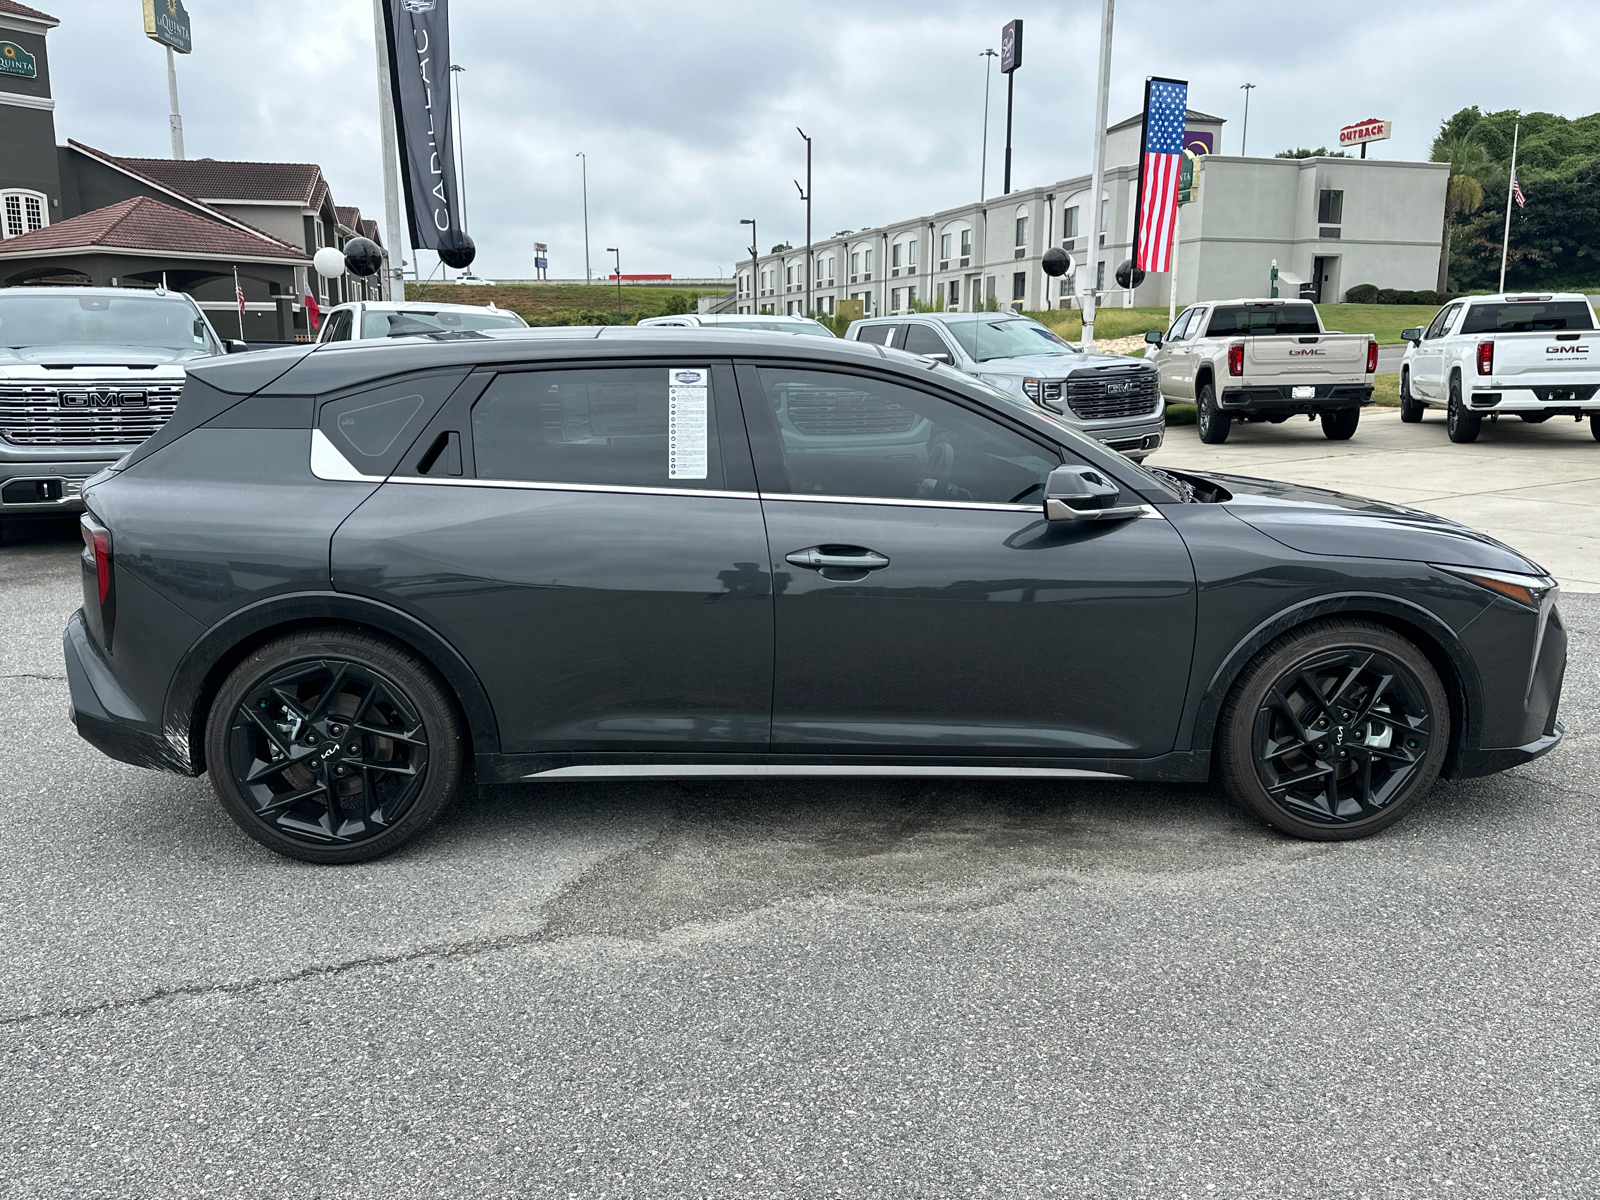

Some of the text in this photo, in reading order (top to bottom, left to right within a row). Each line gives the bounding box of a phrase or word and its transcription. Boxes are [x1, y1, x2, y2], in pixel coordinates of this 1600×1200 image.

[162, 14, 190, 41] QUINTA
[414, 29, 449, 232] CADILLAC
[1339, 125, 1384, 142] OUTBACK
[1289, 348, 1326, 356] GMC
[1546, 346, 1589, 354] GMC
[62, 392, 145, 407] GMC
[337, 646, 371, 660] 235/40
[371, 656, 390, 668] R18
[1400, 764, 1437, 811] KUMHO
[359, 820, 414, 855] KUMHO
